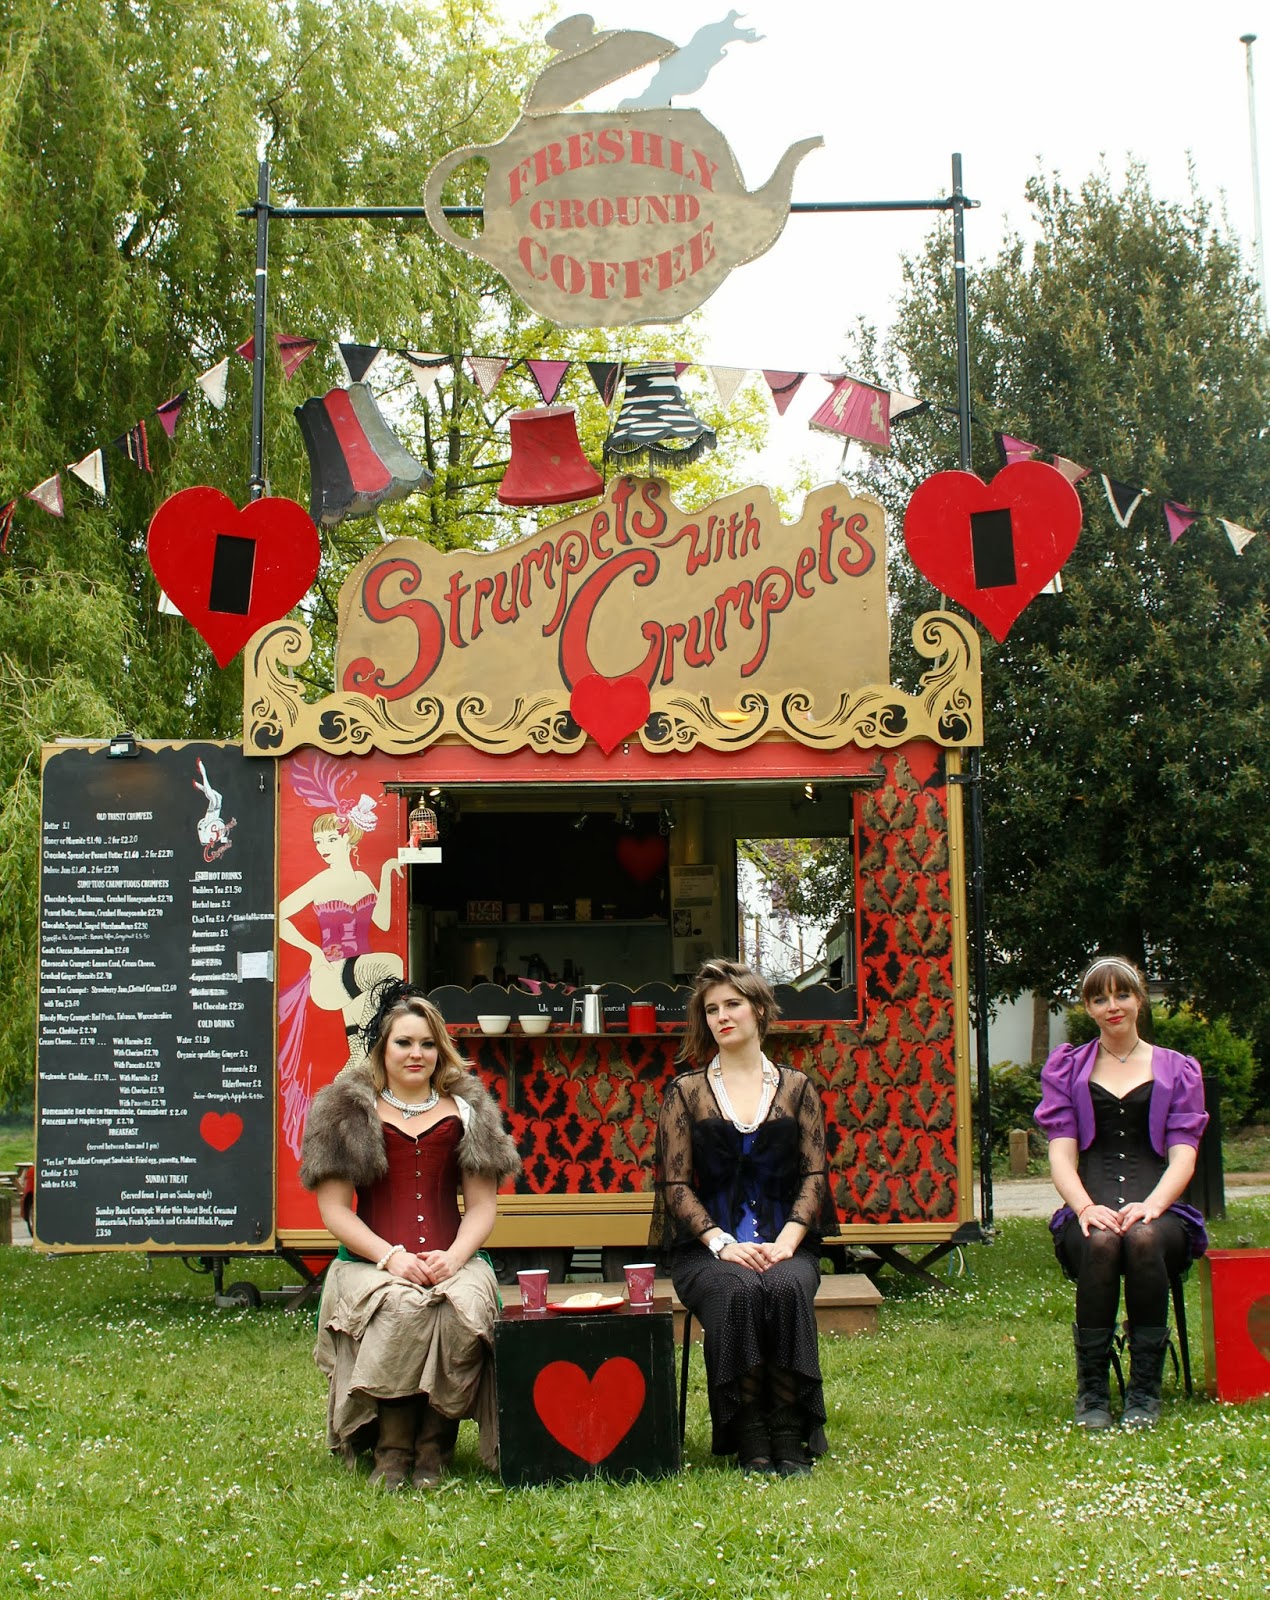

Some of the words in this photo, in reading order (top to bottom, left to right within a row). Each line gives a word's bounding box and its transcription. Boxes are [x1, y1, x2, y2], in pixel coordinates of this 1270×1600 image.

[508, 129, 719, 207] FRESHLY
[529, 194, 700, 230] GROUND
[518, 221, 716, 300] COFFEE
[342, 474, 667, 701] Strumpets
[557, 505, 877, 694] Crumpets
[107, 812, 126, 820] TRUSTY
[127, 812, 152, 820] CRUMPETS
[44, 851, 66, 859] Chocolate
[67, 851, 84, 860] Spread
[91, 851, 108, 859] Peanut
[221, 872, 242, 880] DRINKS
[141, 880, 169, 888] CRUMPETS
[192, 930, 219, 938] Americano
[57, 1014, 69, 1022] Mary
[176, 1051, 196, 1059] Organic
[222, 1050, 239, 1059] Ginger
[145, 1175, 168, 1183] SUNDAY
[169, 1175, 188, 1183] TREAT
[121, 1191, 141, 1200] (Served
[141, 1191, 154, 1199] from
[177, 1190, 196, 1200] Sunday
[95, 1207, 114, 1215] Sunday
[115, 1206, 130, 1214] Roast
[155, 1206, 171, 1214] Wafer
[172, 1206, 182, 1214] thin
[183, 1206, 198, 1214] Roast
[213, 1206, 237, 1214] Creamed
[129, 1217, 144, 1225] Fresh
[144, 1217, 165, 1226] Spinach
[176, 1217, 197, 1225] Cracked
[198, 1217, 213, 1225] Black
[214, 1217, 234, 1226] Pepper
